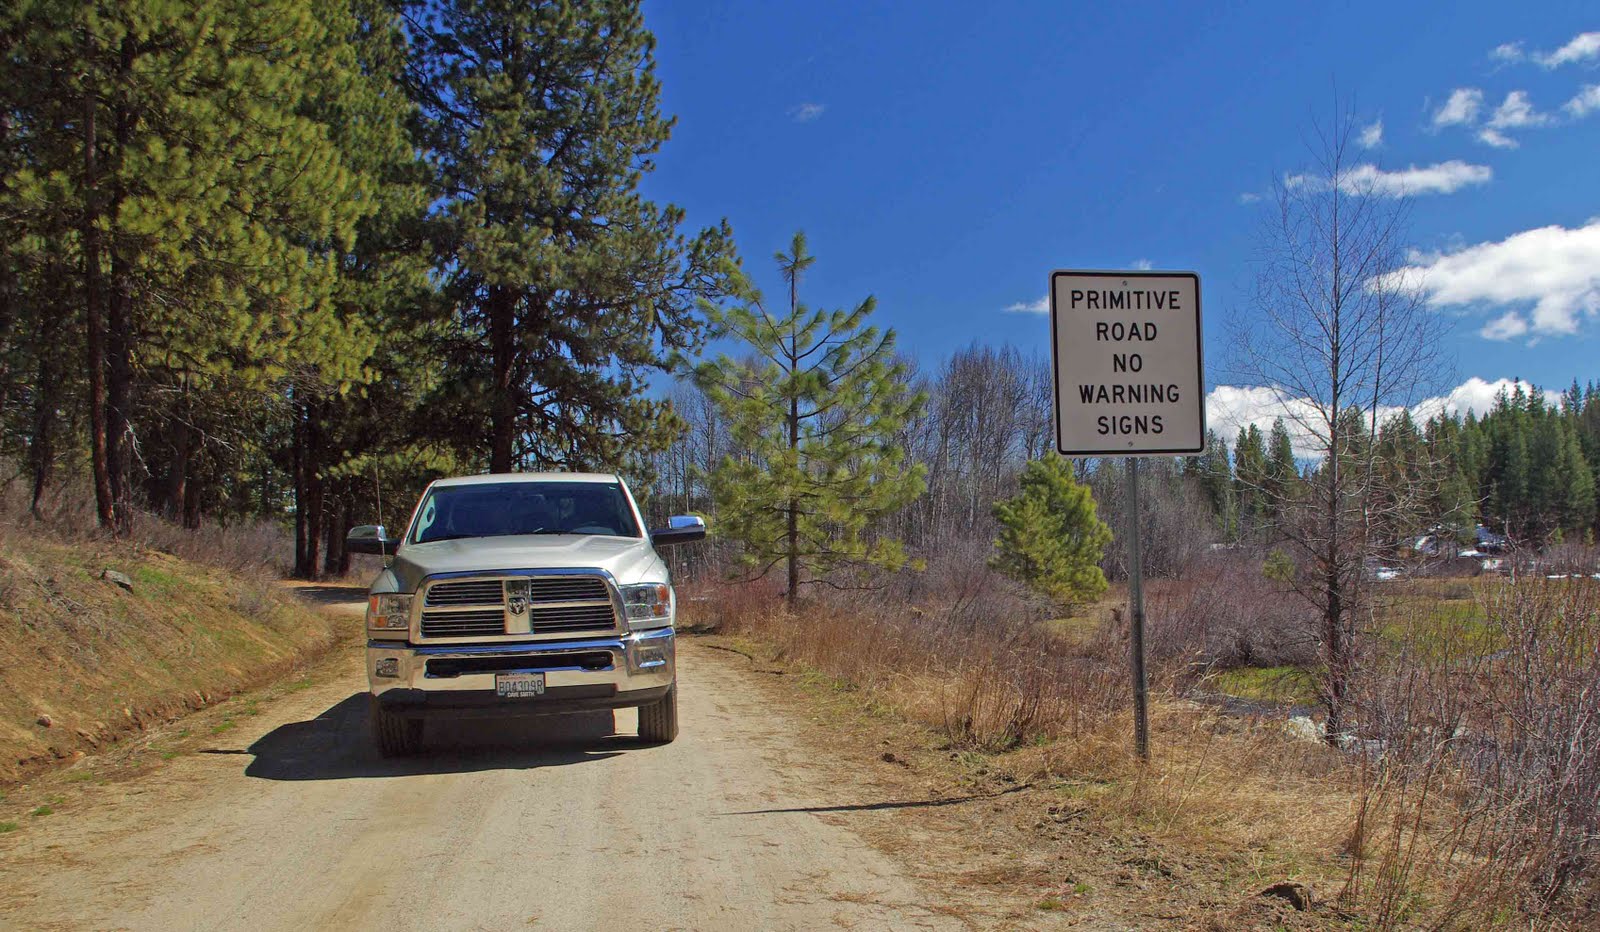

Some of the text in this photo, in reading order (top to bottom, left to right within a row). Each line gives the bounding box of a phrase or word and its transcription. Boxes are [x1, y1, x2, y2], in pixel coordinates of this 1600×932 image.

[1071, 290, 1181, 310] PRIMITIVE
[1096, 322, 1158, 341] ROAD
[1113, 353, 1143, 373] NO
[1079, 384, 1180, 404] WARNING
[1097, 415, 1164, 435] SIGNS
